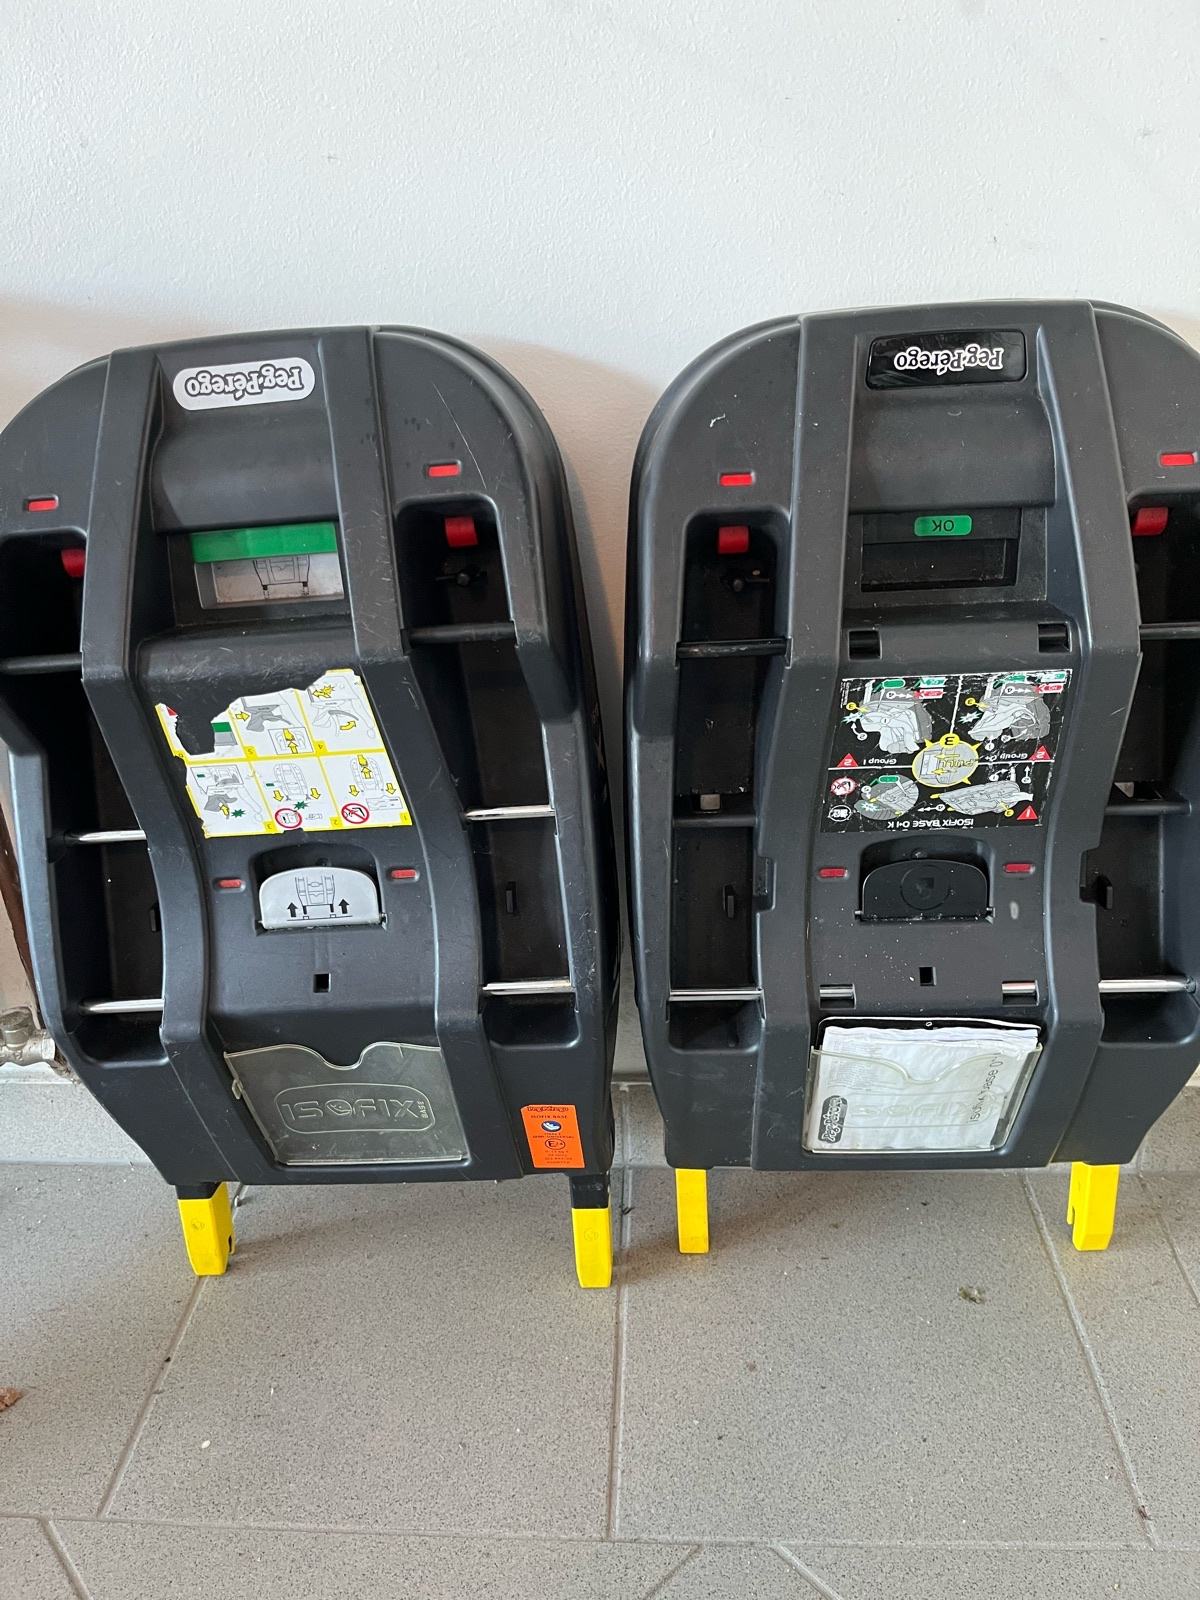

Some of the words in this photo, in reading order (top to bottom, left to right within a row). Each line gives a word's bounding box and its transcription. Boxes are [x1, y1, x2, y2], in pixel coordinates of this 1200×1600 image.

[932, 520, 954, 532] OK
[945, 737, 955, 745] 3
[912, 819, 939, 828] BASE
[943, 818, 973, 827] ISOFIX
[281, 1098, 419, 1121] ISOFIX
